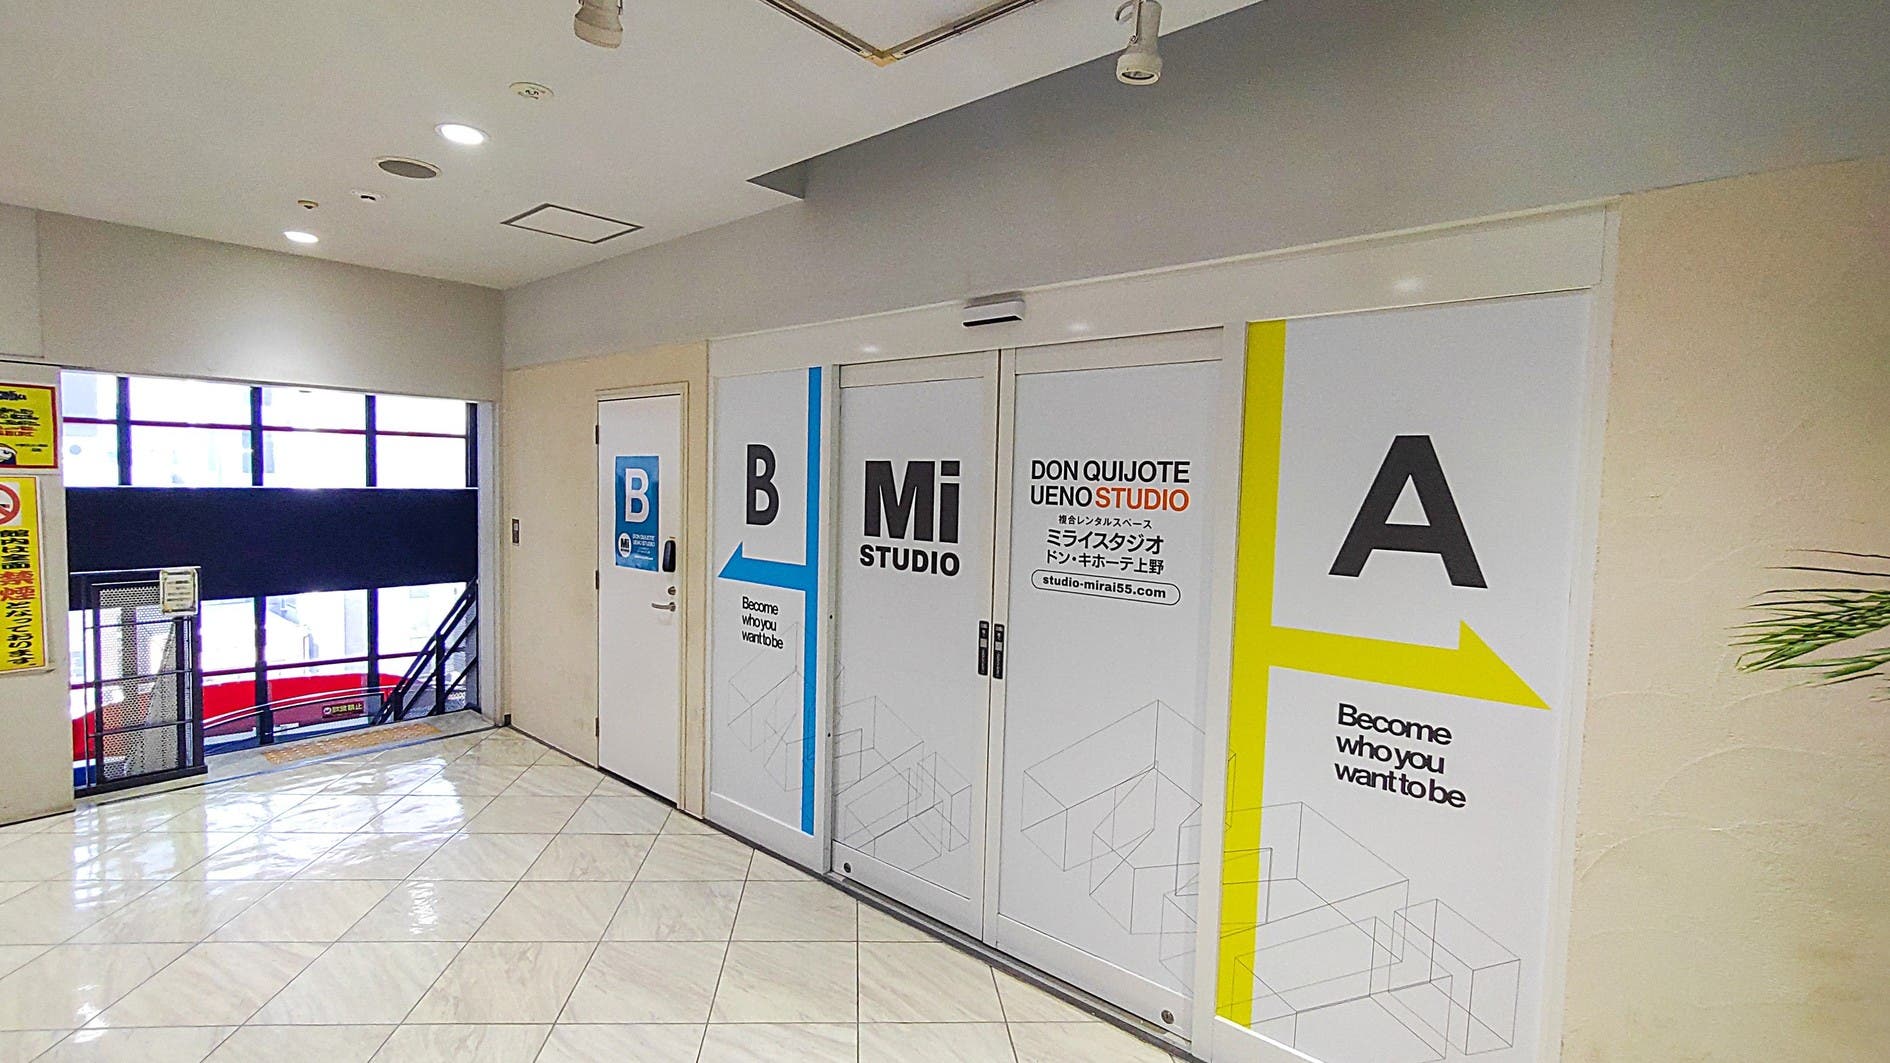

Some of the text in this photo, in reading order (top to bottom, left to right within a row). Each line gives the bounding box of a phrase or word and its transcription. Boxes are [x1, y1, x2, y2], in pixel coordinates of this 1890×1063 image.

[746, 444, 780, 526] B
[1031, 459, 1191, 484] DON QUIJOTE
[625, 468, 650, 523] B
[863, 460, 961, 544] Mi
[1030, 485, 1190, 512] UENO STUDIO
[1058, 514, 1153, 530] 複合レンタルスペース
[1328, 434, 1489, 589] A
[1046, 528, 1164, 555] ミライスタジオ
[859, 544, 961, 577] STUDIO
[1046, 549, 1165, 575] ドン・キホーテ上野
[1042, 574, 1167, 598] studio-mirai55.com
[742, 595, 779, 615] Become
[741, 613, 777, 632] who you
[741, 630, 784, 650] want to be
[1338, 702, 1453, 745] Become
[1335, 734, 1445, 775] who you
[1334, 762, 1467, 809] want to be
